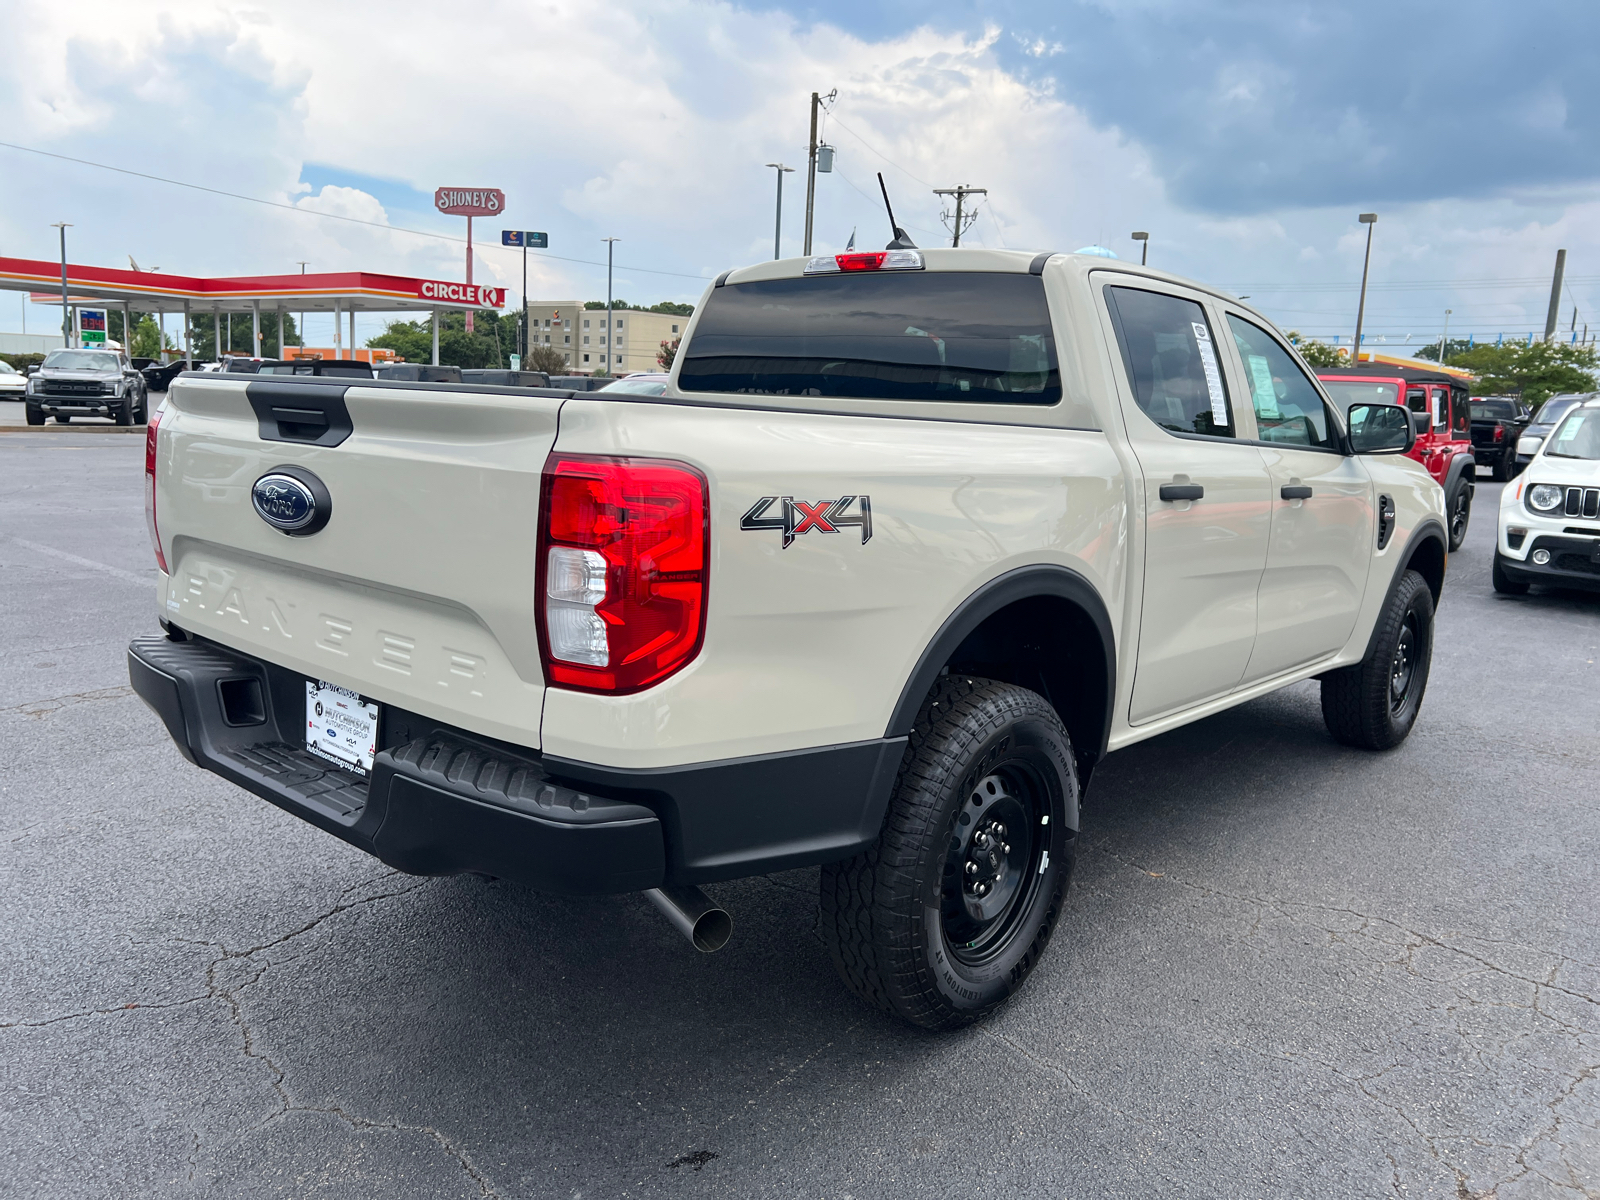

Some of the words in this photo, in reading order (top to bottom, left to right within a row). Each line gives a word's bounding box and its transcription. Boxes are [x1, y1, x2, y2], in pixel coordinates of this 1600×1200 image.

[438, 190, 499, 211] SHONEY'S
[421, 281, 475, 302] CIRCLE
[480, 286, 497, 307] K
[263, 485, 298, 516] Ford
[325, 707, 371, 733] HUTCHINSON
[325, 718, 353, 735] AUTOMOTIVE
[353, 729, 368, 739] GROUP
[935, 950, 944, 965] AT
[942, 969, 983, 1000] TERRITORY
